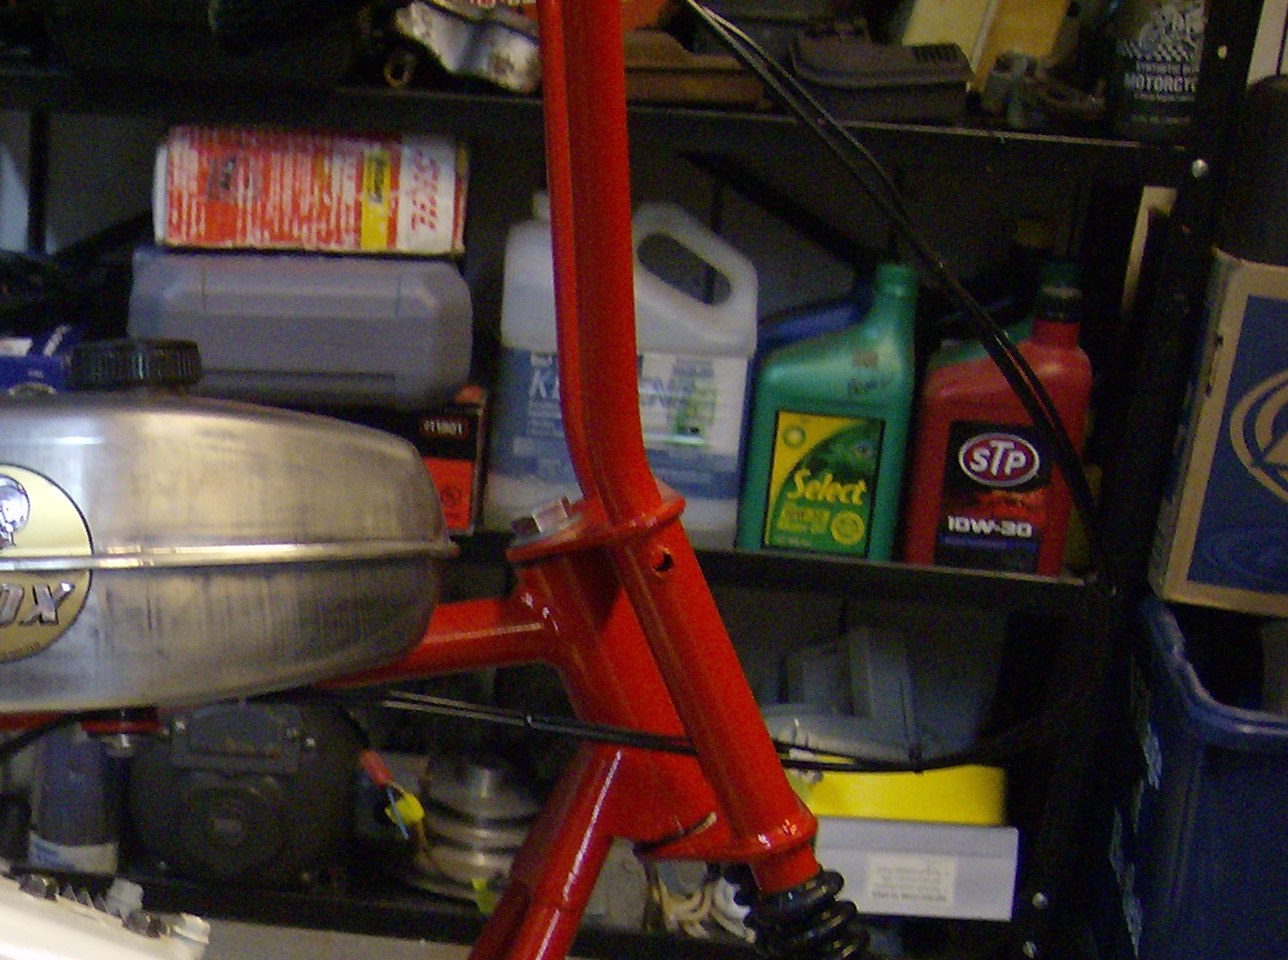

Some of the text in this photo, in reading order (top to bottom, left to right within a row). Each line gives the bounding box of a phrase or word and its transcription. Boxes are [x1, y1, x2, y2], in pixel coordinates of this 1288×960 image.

[969, 440, 1027, 476] STP
[787, 468, 868, 506] Select
[947, 515, 1033, 539] 10W-30
